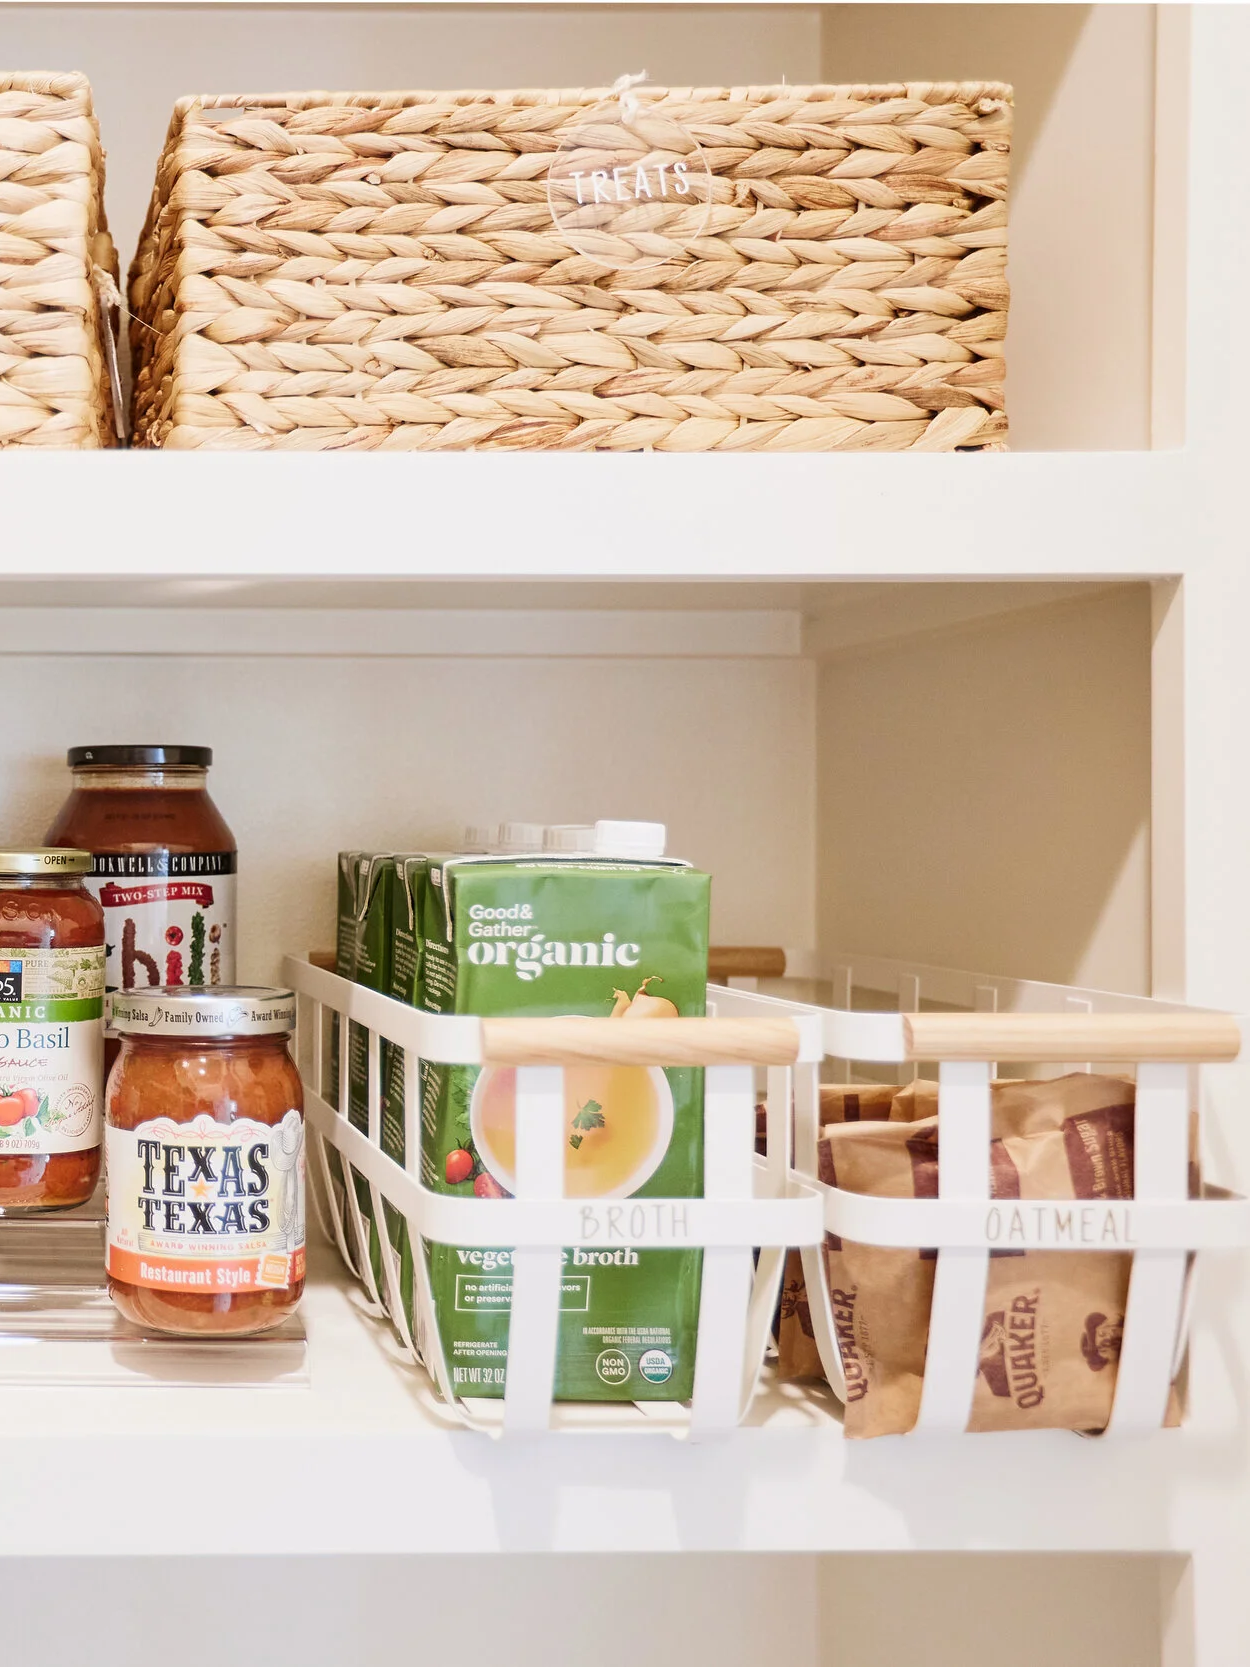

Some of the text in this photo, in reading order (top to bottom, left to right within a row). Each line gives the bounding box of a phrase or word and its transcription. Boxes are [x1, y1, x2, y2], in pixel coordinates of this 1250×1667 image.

[569, 162, 690, 204] TREATS
[44, 855, 67, 865] OPEN
[157, 855, 223, 872] & COMPANY
[112, 886, 204, 903] TWO-STEP MIX
[469, 903, 534, 920] Good&
[468, 921, 531, 938] Gather
[425, 938, 449, 955] Directions
[25, 959, 49, 968] PURE
[467, 932, 640, 981] organic
[132, 1009, 149, 1022] Salsa
[164, 1012, 224, 1023] Family Owned
[251, 1010, 272, 1022] Award
[16, 1026, 70, 1049] Basil
[11, 1139, 23, 1149] OZ)
[24, 1139, 40, 1149] 709g
[1074, 1119, 1108, 1192] Brown Sugar
[137, 1139, 270, 1197] TEXAS
[138, 1197, 271, 1235] TEXAS
[579, 1204, 689, 1240] BROTH
[984, 1205, 1139, 1244] OATMEAL
[150, 1239, 268, 1251] AWARD WINNING SALSA
[572, 1247, 639, 1266] broth
[140, 1262, 251, 1288] Restaurant Style
[832, 1288, 869, 1403] QUAKER
[1009, 1294, 1045, 1409] QUAKER
[602, 1358, 624, 1367] NON
[646, 1357, 665, 1365] USDA
[453, 1367, 505, 1383] NET WT 32 OZ
[602, 1367, 625, 1376] GMO
